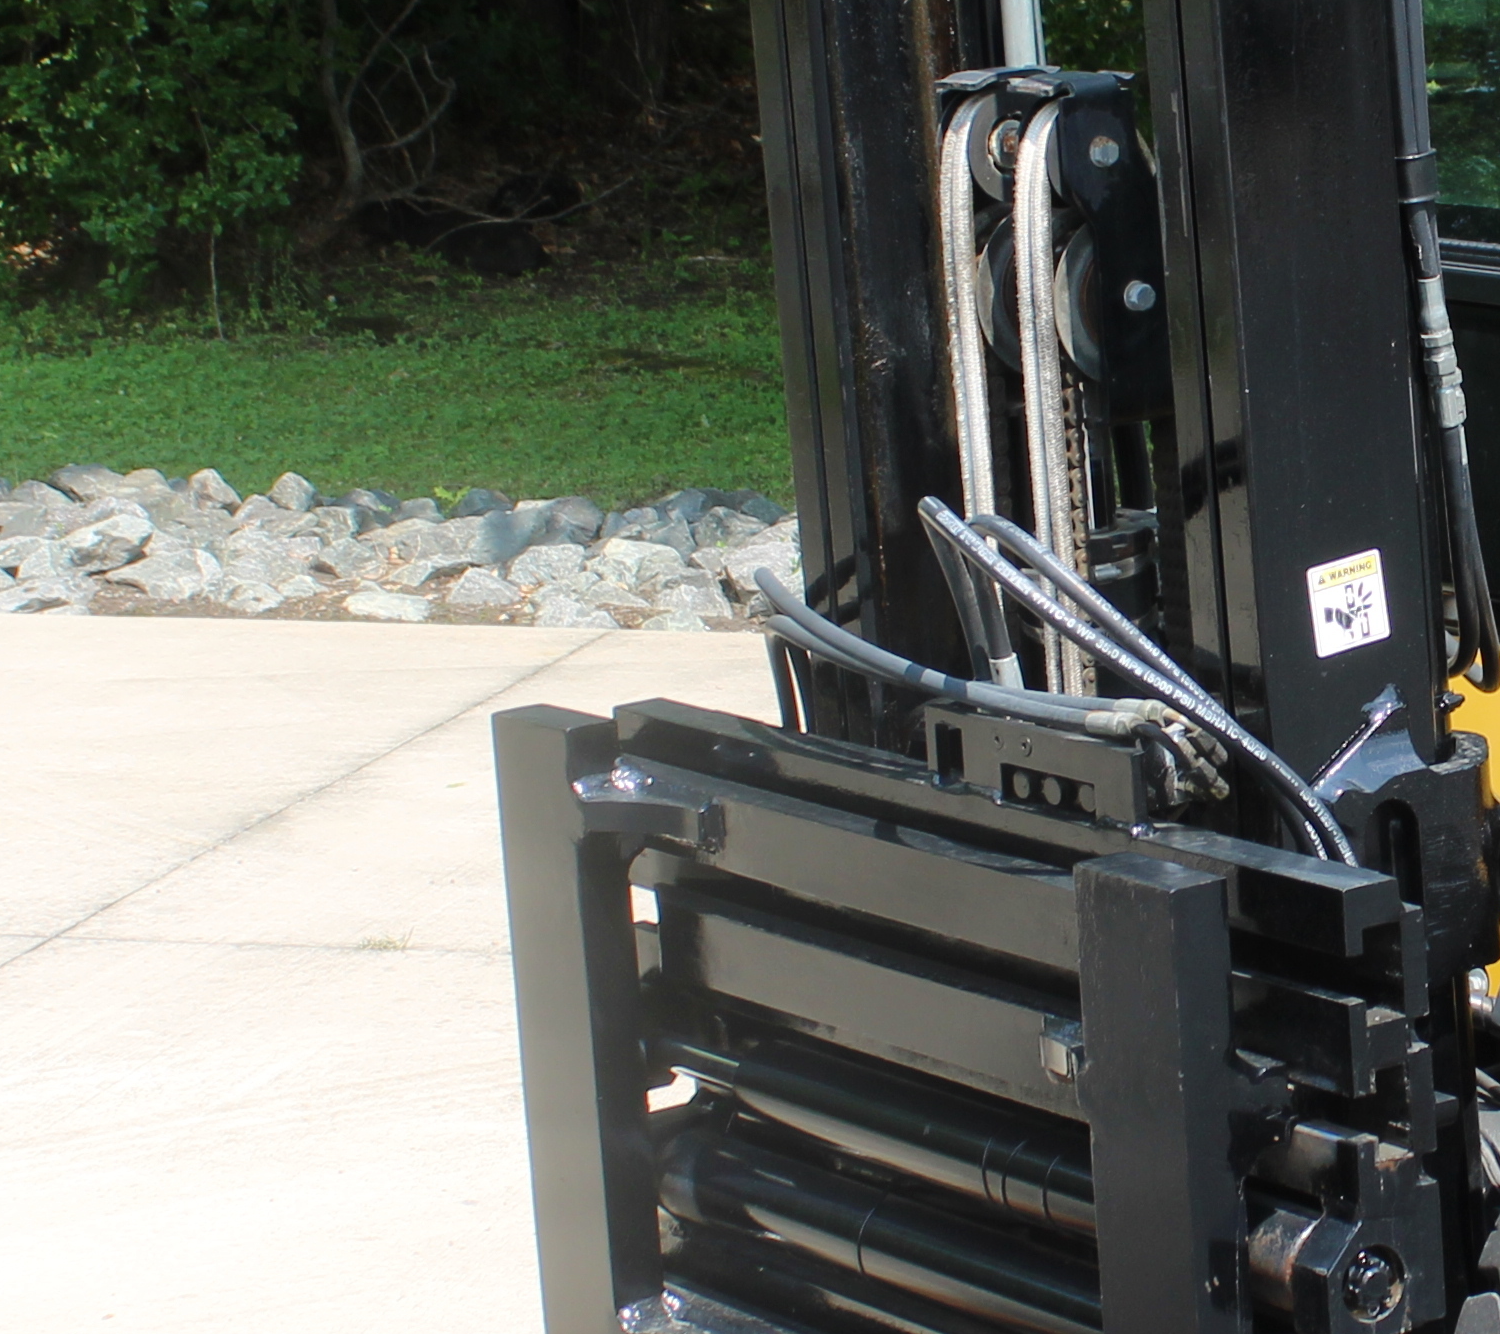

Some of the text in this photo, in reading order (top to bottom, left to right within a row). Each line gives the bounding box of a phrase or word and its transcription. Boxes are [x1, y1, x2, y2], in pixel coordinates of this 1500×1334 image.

[1328, 560, 1373, 581] WARNING
[1076, 624, 1096, 642] WP
[1118, 655, 1143, 678] MPa
